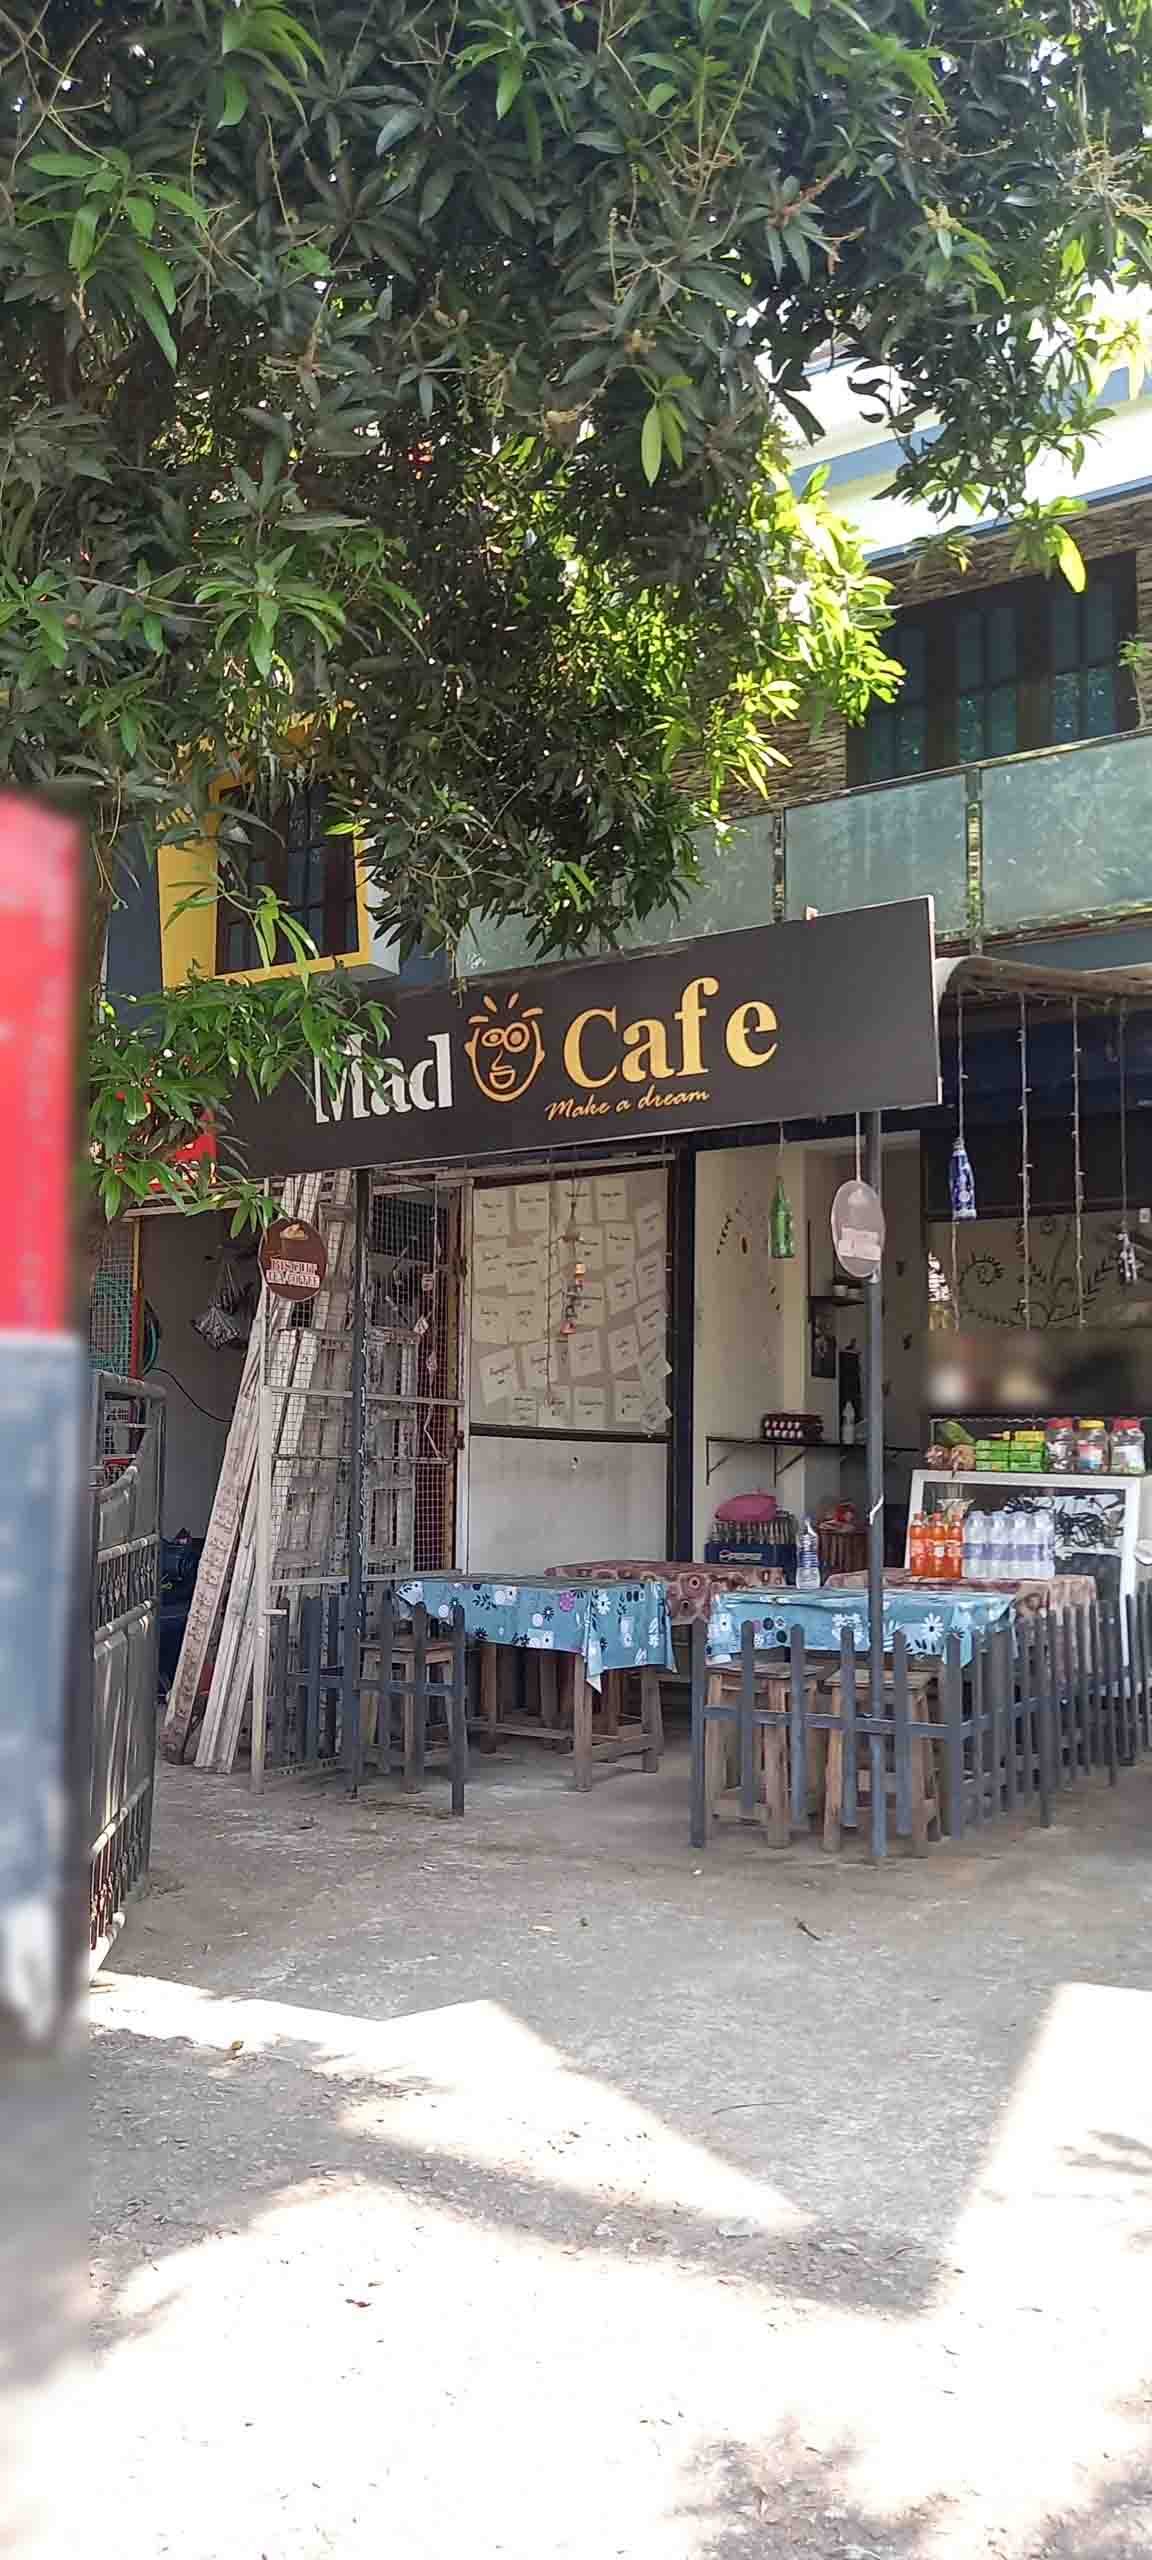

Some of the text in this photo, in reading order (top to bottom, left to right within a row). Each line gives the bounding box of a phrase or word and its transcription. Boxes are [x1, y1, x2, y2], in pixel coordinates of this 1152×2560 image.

[314, 976, 778, 1123] Mad Cafe
[545, 1084, 710, 1120] Make a dream
